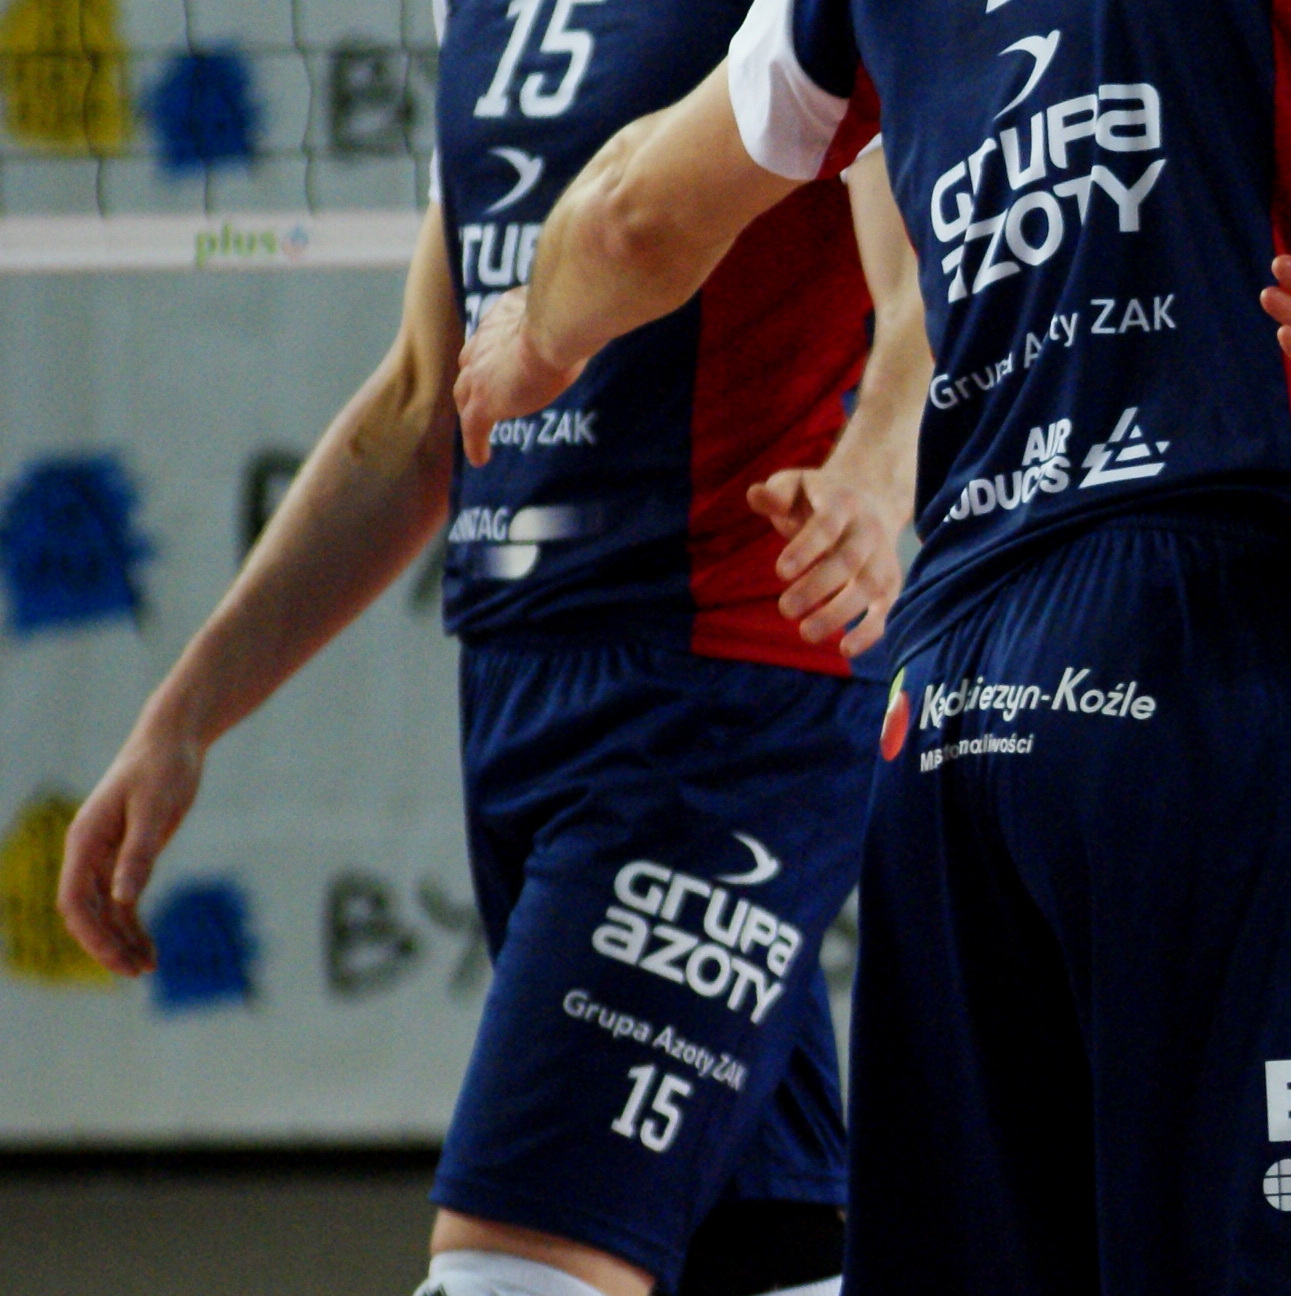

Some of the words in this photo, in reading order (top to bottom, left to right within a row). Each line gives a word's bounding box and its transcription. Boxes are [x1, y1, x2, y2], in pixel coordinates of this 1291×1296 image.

[195, 223, 278, 268] plus
[1090, 293, 1178, 335] ZAK
[488, 415, 540, 453] zoty
[540, 410, 596, 446] ZAK
[1021, 417, 1073, 467] AIR
[562, 988, 654, 1042] Grupa
[652, 1025, 715, 1077] Azoty
[610, 1062, 694, 1154] 15
